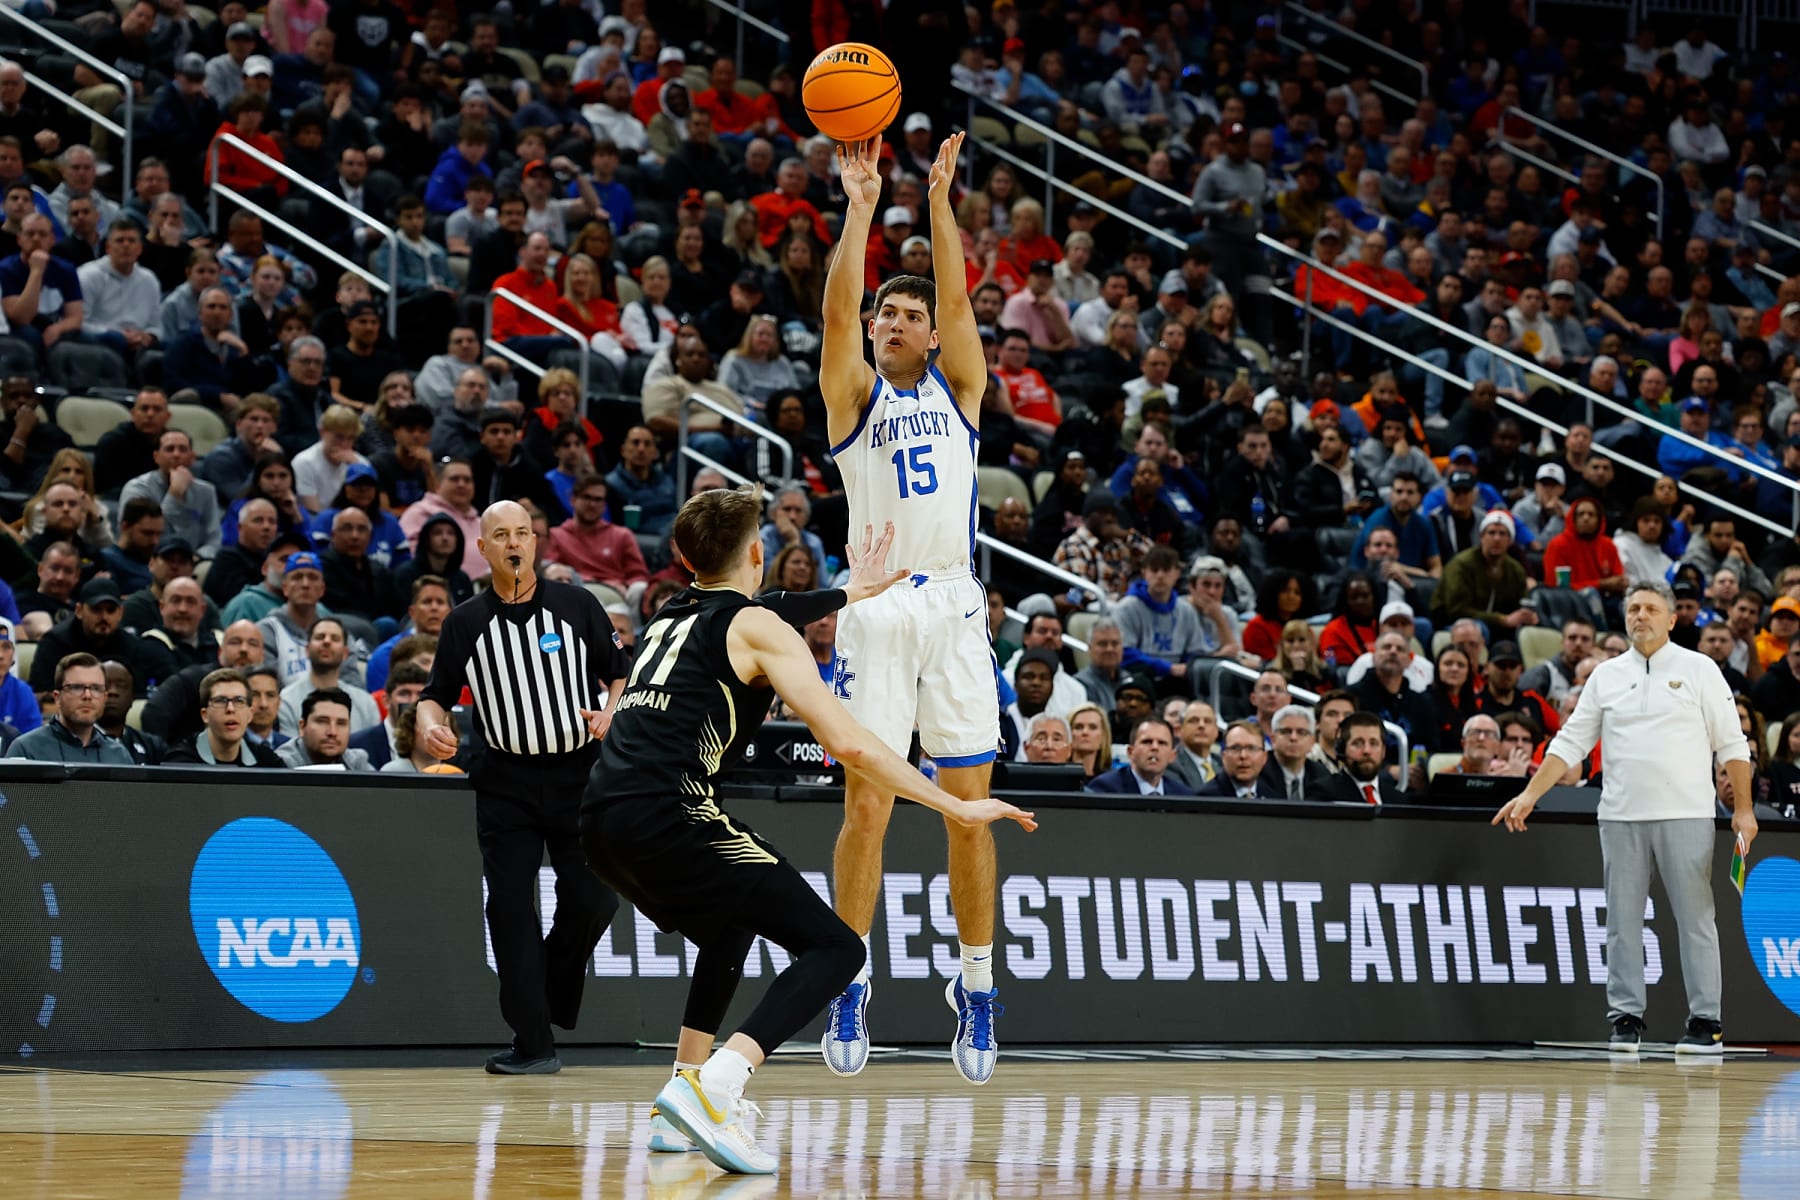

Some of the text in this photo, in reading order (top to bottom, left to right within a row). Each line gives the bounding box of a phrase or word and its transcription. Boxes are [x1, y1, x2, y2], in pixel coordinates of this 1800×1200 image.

[871, 411, 950, 449] KNTUCKY
[892, 444, 938, 499] 15
[627, 614, 698, 689] 11
[793, 743, 824, 762] POSS
[216, 918, 360, 968] NCAA
